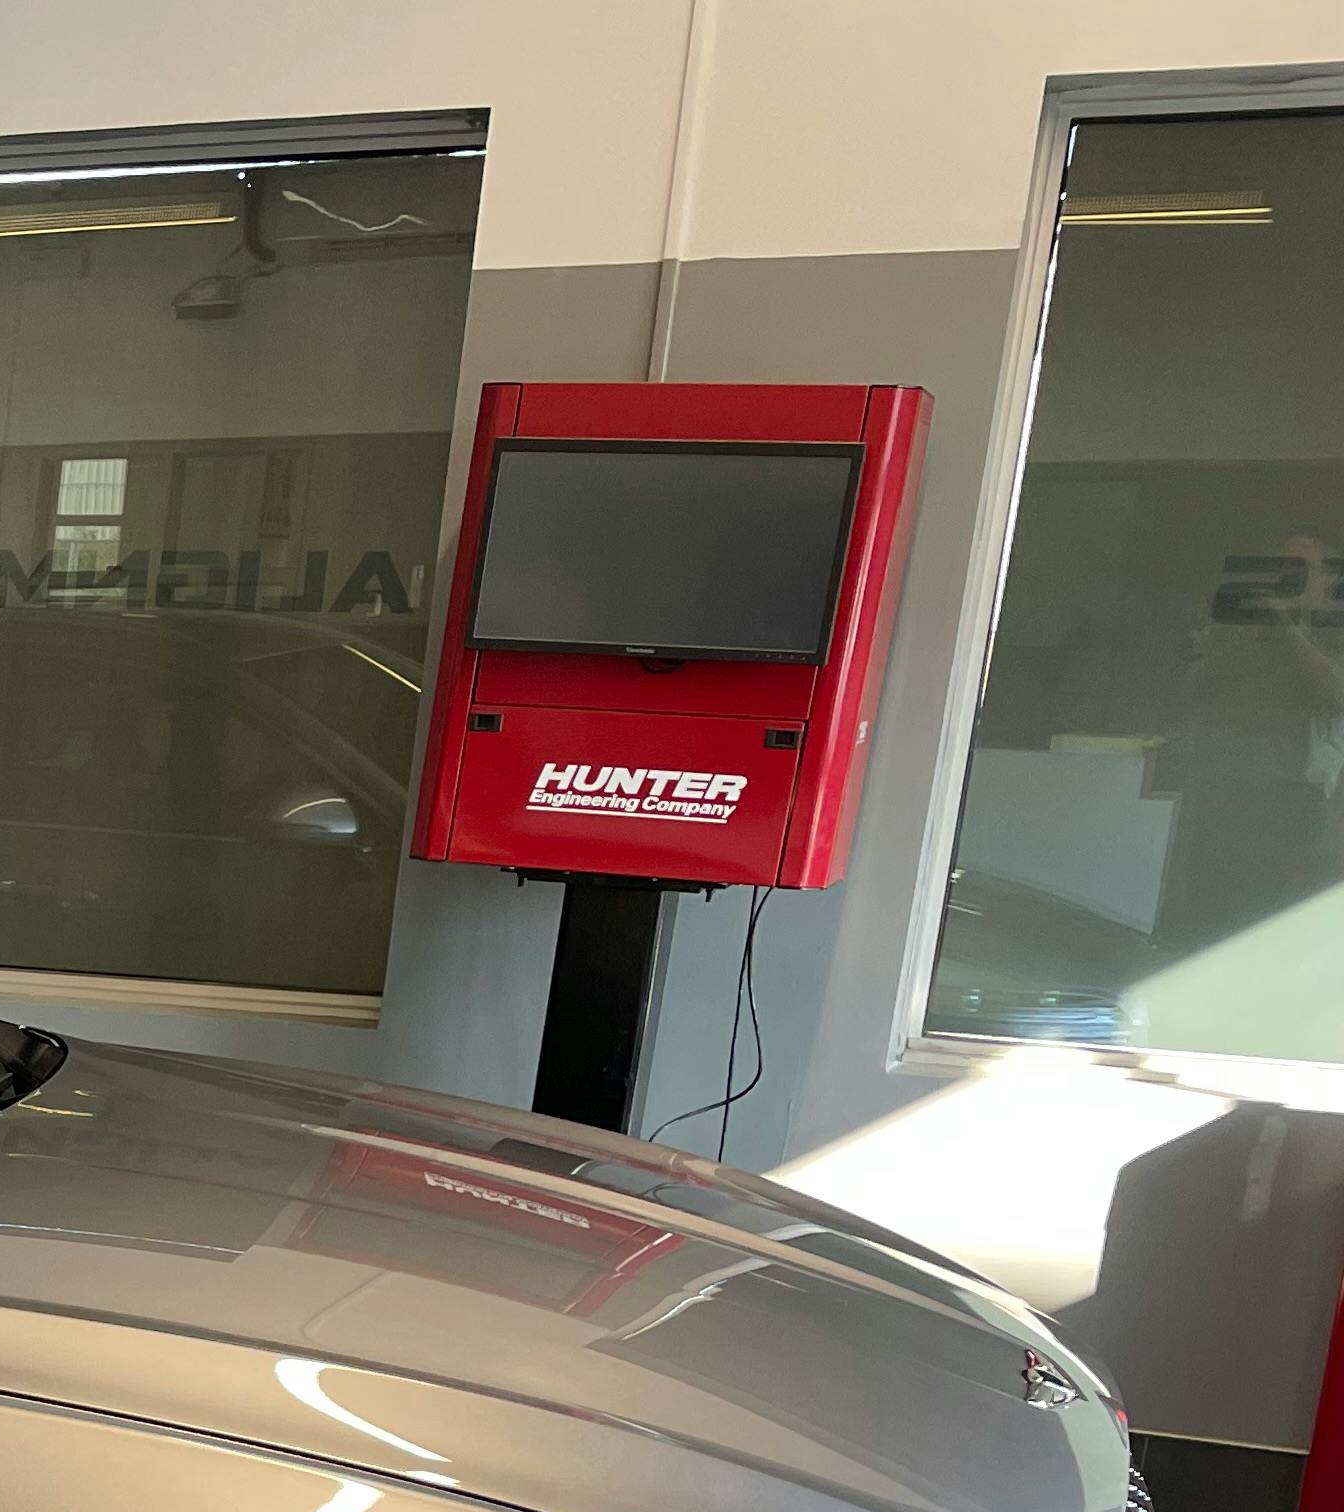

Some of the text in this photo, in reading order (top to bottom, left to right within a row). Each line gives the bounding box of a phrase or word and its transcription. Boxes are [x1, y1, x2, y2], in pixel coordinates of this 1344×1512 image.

[535, 763, 748, 801] HUNTER
[529, 789, 736, 819] Engineering Company
